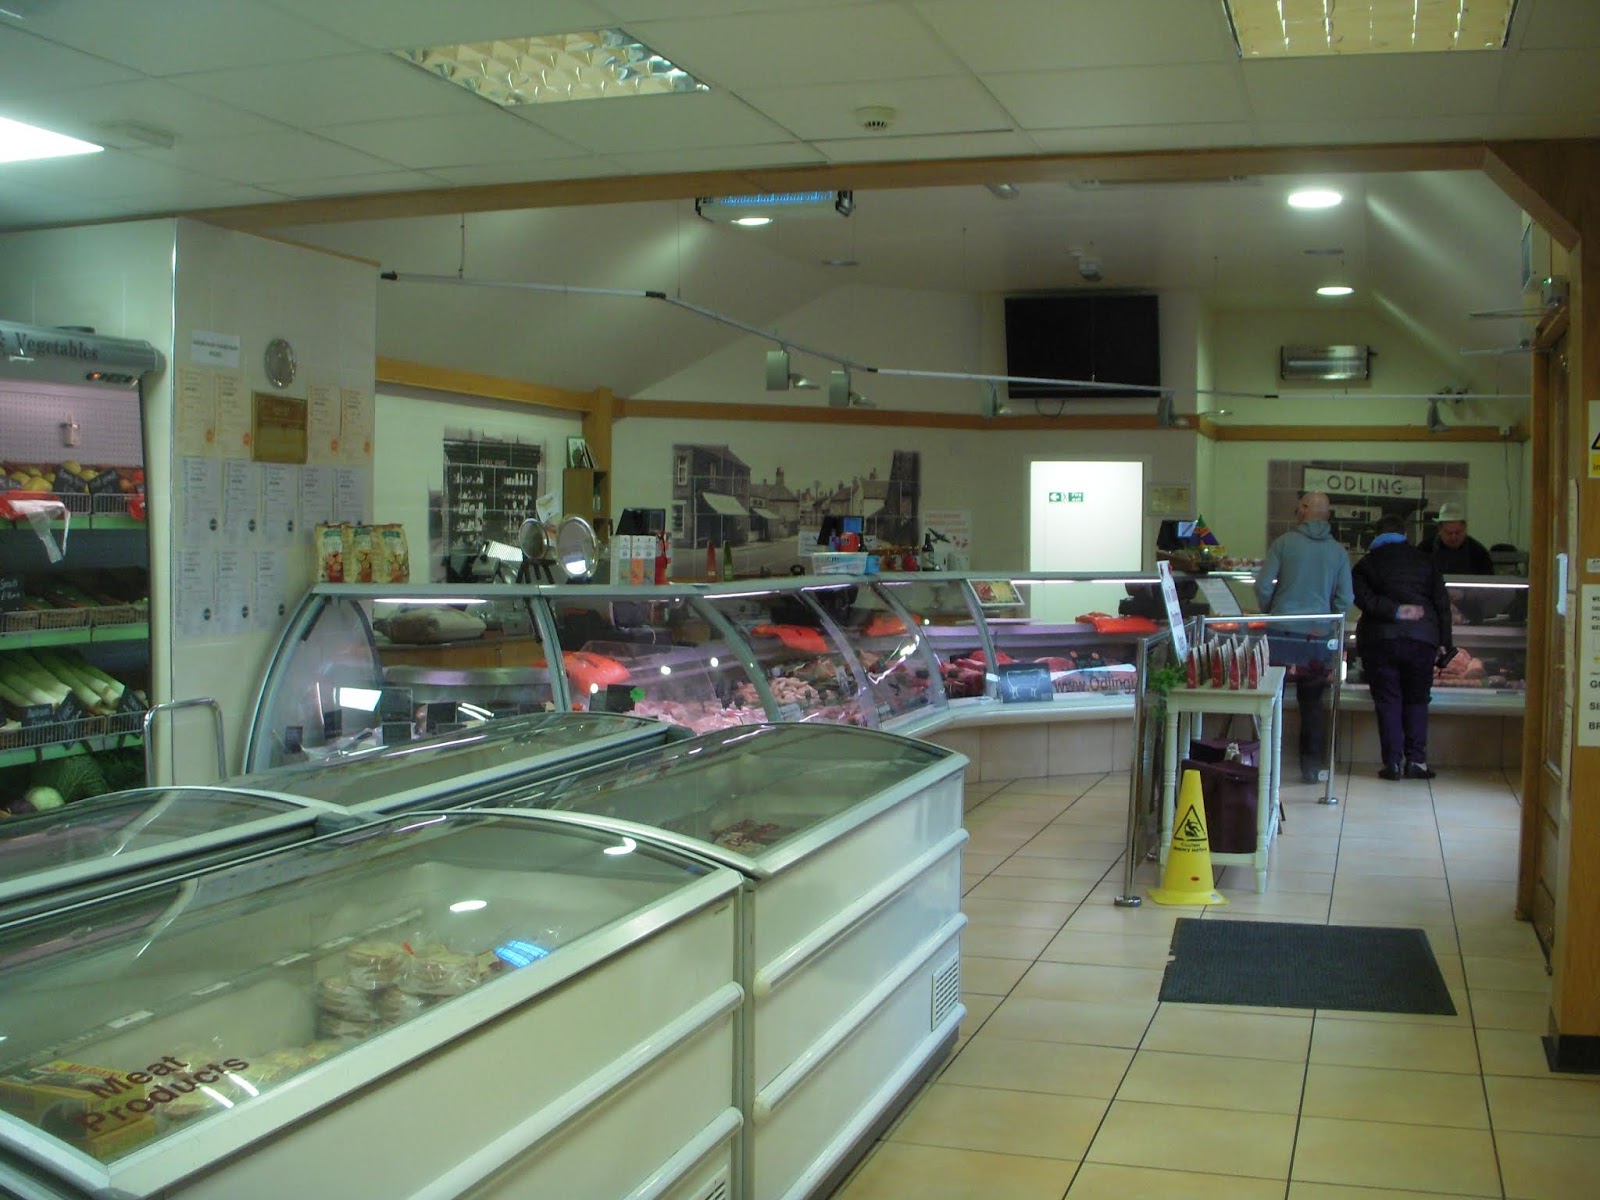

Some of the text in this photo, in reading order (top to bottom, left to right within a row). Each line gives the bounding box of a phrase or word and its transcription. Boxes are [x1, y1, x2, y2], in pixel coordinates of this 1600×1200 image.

[14, 331, 99, 361] Vegetables
[1327, 474, 1403, 496] ODLING
[76, 1058, 249, 1132] Products
[85, 1056, 189, 1099] Meat
